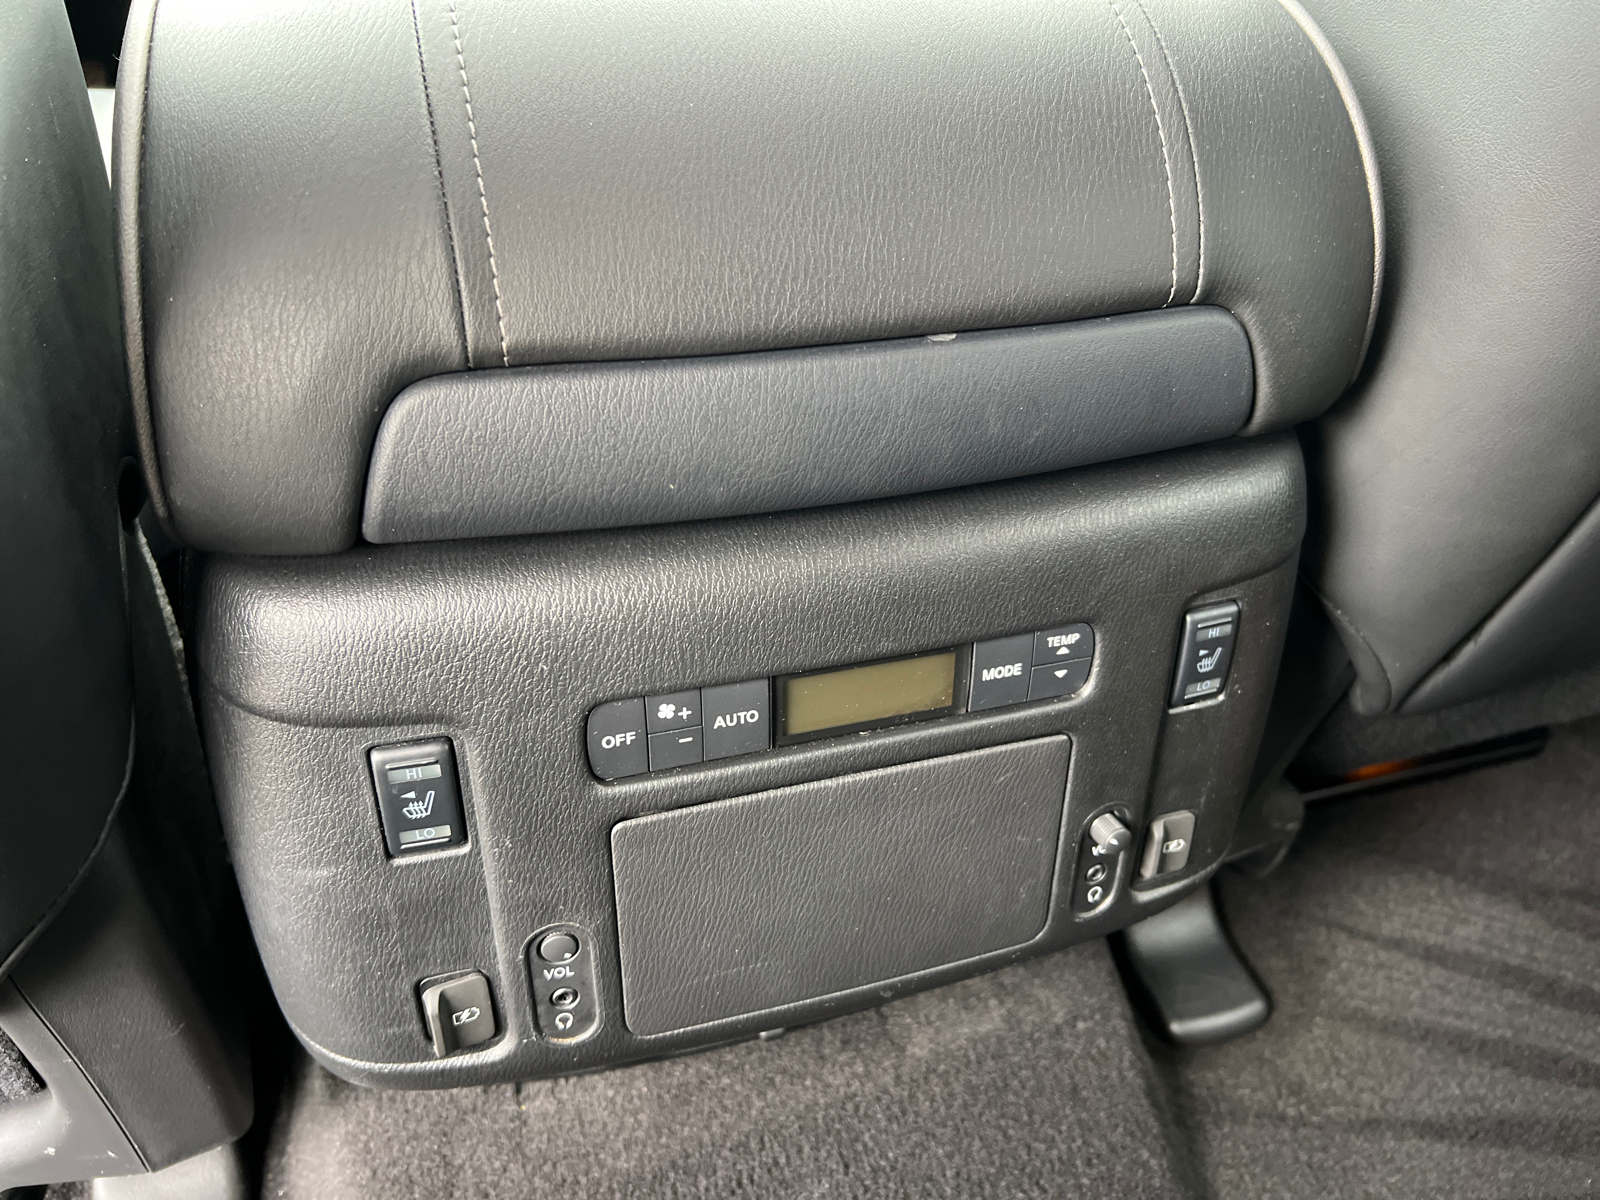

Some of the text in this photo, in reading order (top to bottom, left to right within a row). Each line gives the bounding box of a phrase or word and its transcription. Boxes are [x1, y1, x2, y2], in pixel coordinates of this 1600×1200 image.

[1047, 632, 1081, 648] TEMP
[1208, 627, 1220, 638] HI
[982, 662, 1023, 681] MODE
[1196, 680, 1211, 691] LO
[713, 709, 759, 730] AUTO
[601, 731, 636, 749] OFF
[405, 767, 423, 780] HI
[415, 827, 436, 840] LO
[543, 965, 575, 981] VOL
